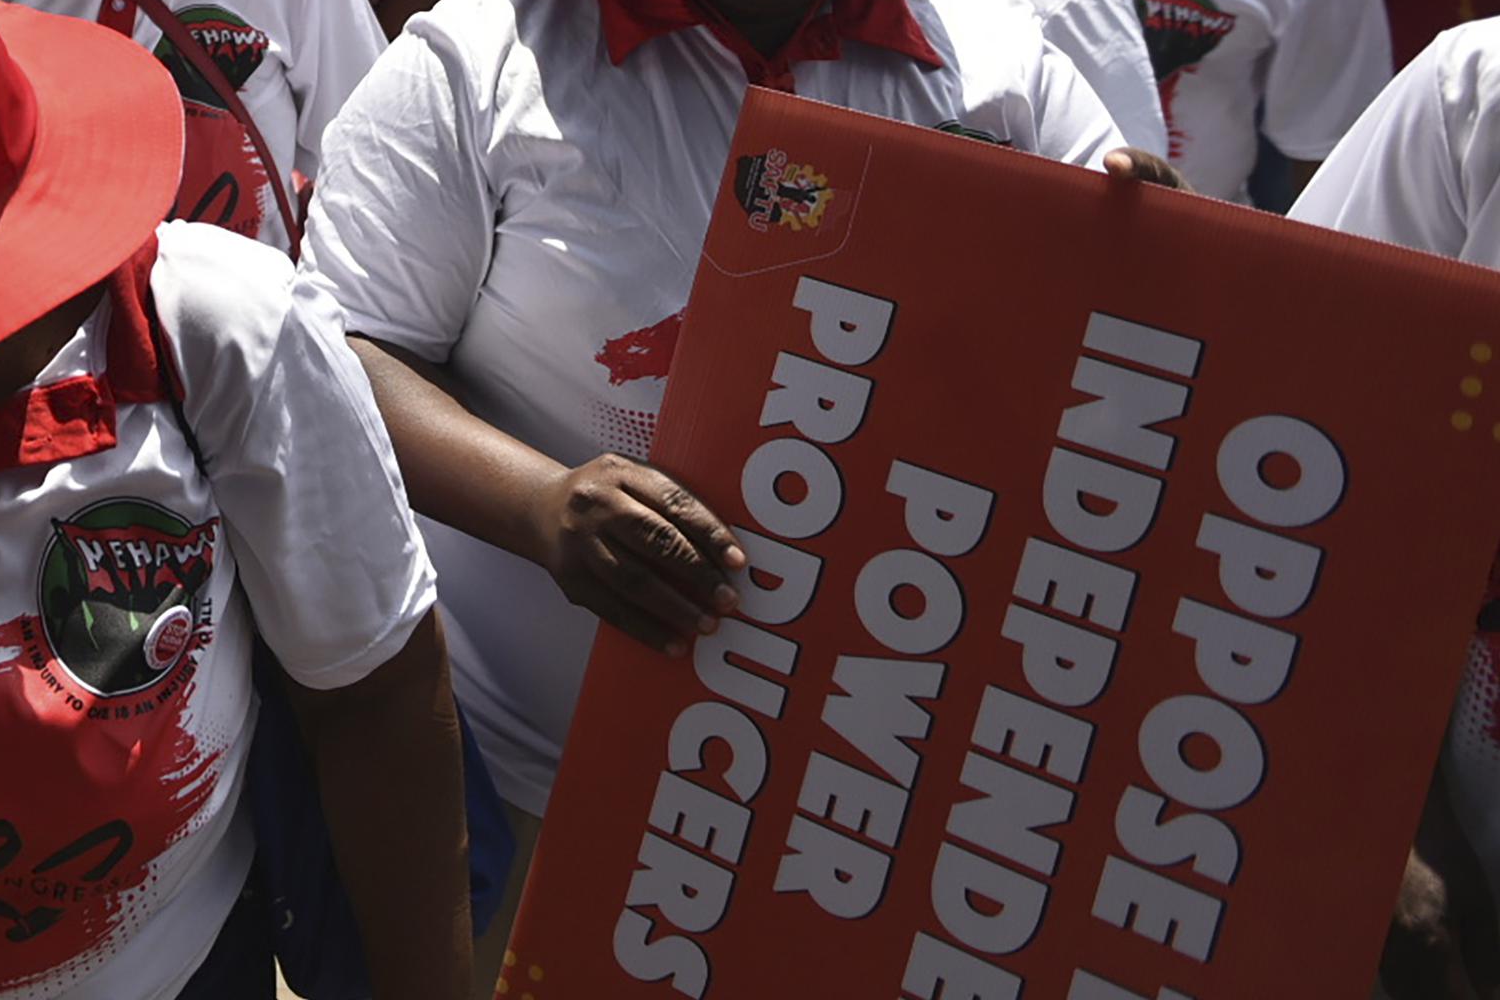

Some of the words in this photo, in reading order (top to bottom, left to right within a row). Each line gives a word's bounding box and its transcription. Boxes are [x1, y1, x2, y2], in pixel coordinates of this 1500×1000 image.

[748, 147, 787, 233] SAFTU
[65, 692, 83, 711] TO
[613, 275, 898, 1000] PRODUCERS
[773, 460, 995, 919] POWER
[1092, 414, 1347, 961] OPPOSE
